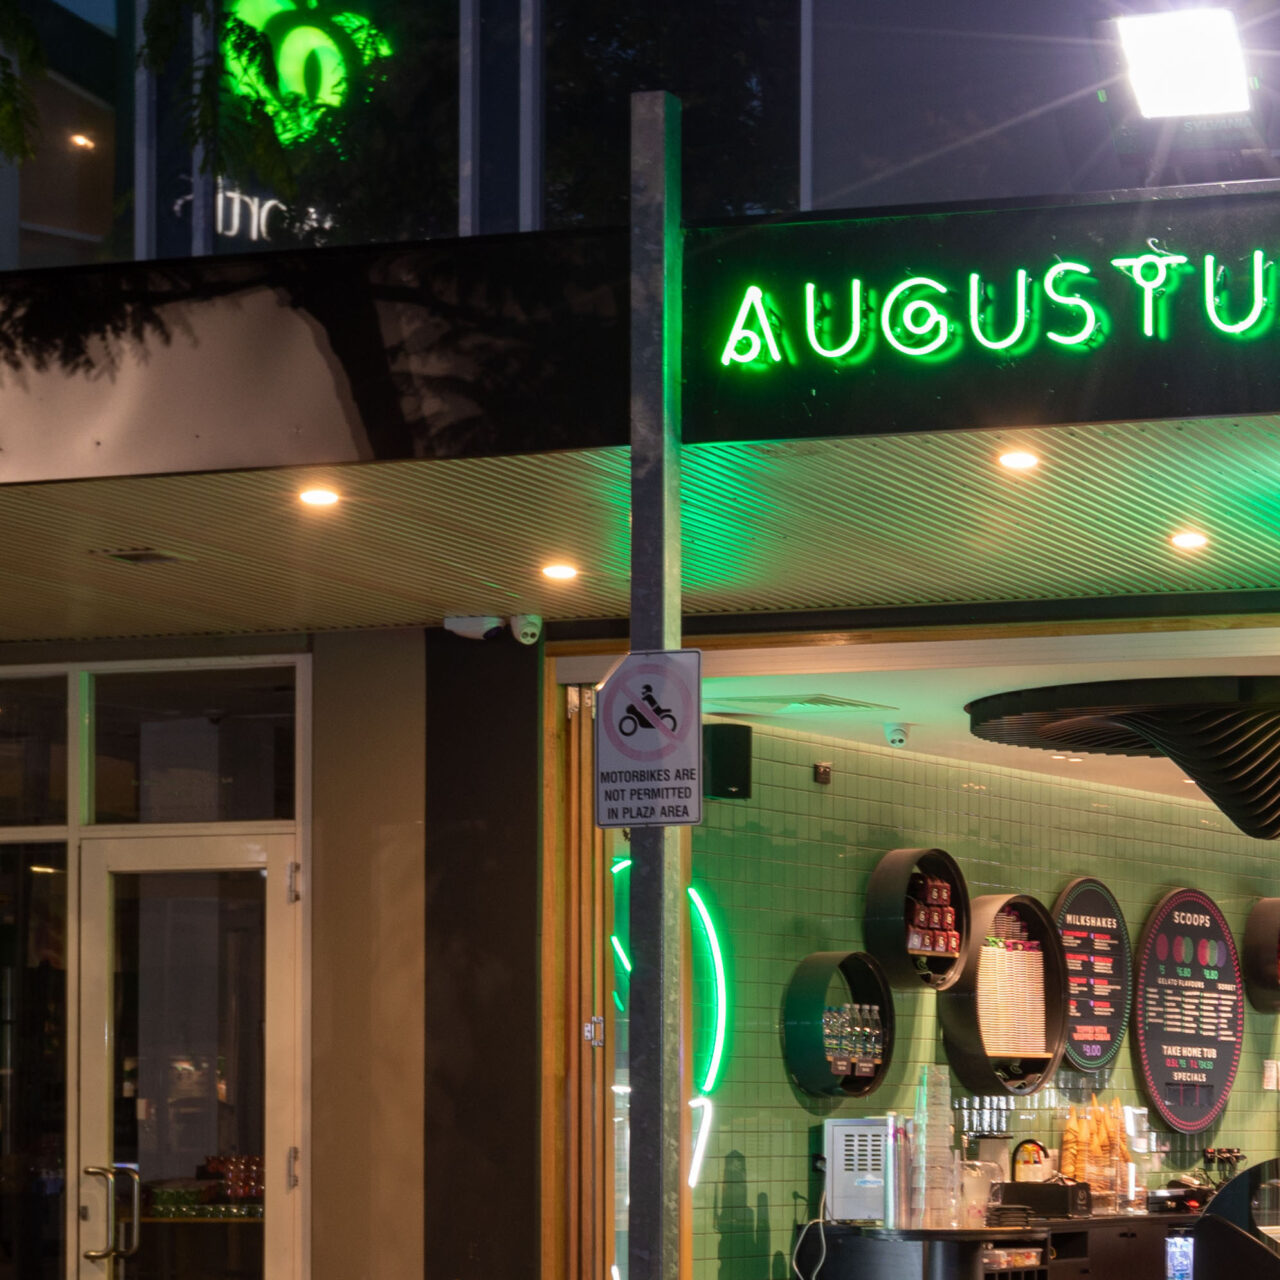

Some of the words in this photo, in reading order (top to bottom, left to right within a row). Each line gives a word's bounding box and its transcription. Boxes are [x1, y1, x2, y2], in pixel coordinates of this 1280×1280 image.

[601, 769, 671, 784] MOTORBIKES
[675, 768, 697, 781] ARE
[605, 788, 627, 801] NOT
[630, 786, 692, 800] PERMITTED
[608, 807, 618, 819] IN
[622, 806, 656, 819] PLAZA
[660, 805, 689, 817] AREA
[1066, 914, 1117, 929] MILKSHAKES
[1173, 911, 1211, 927] SCOOPS
[1161, 1045, 1181, 1057] TAKE
[1181, 1046, 1202, 1058] HOME
[1172, 1071, 1207, 1082] SPECIALS
